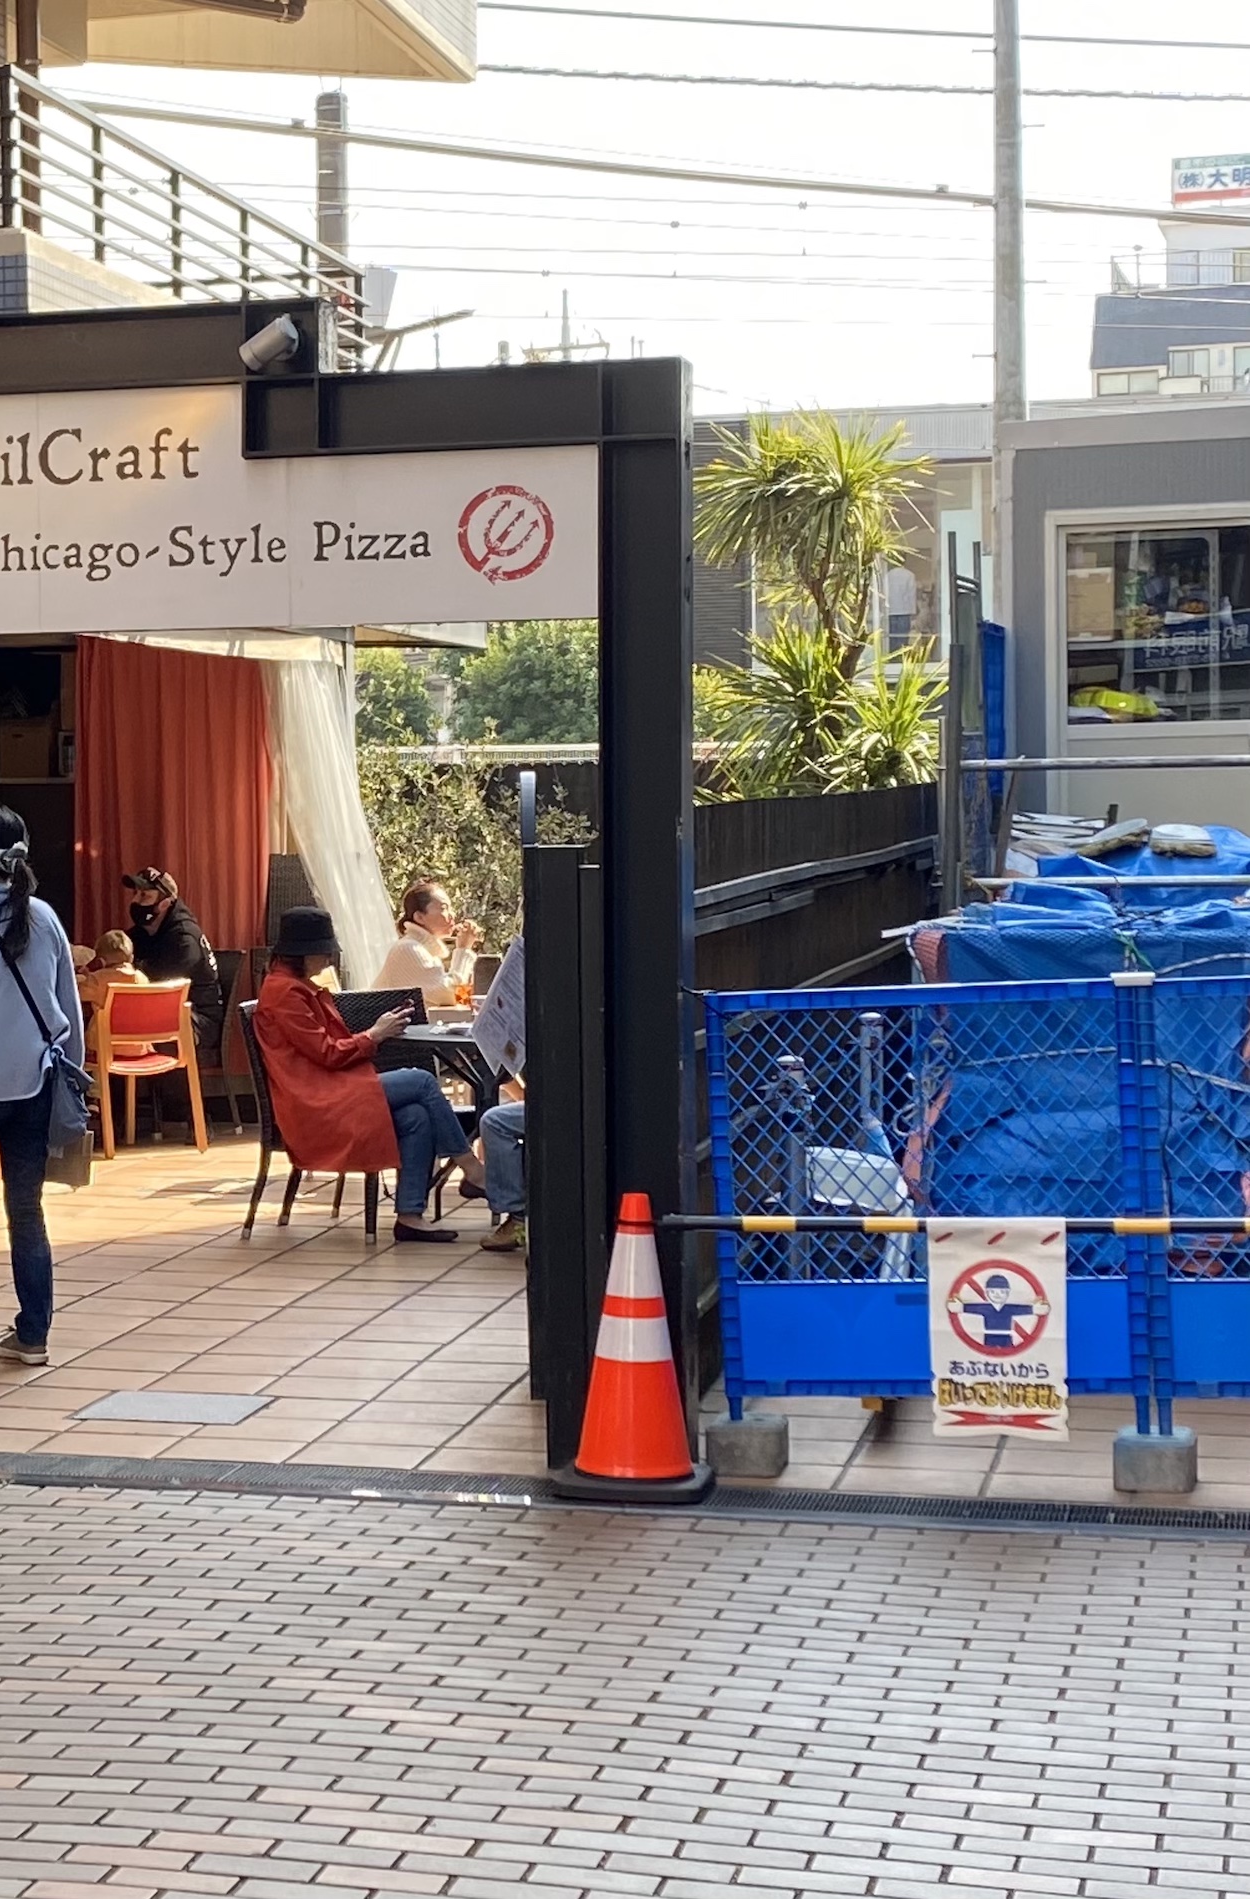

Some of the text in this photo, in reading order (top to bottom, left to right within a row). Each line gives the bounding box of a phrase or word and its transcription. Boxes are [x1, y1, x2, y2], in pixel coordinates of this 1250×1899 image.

[313, 520, 432, 562] Pizza
[949, 1360, 1050, 1378] あぶないから
